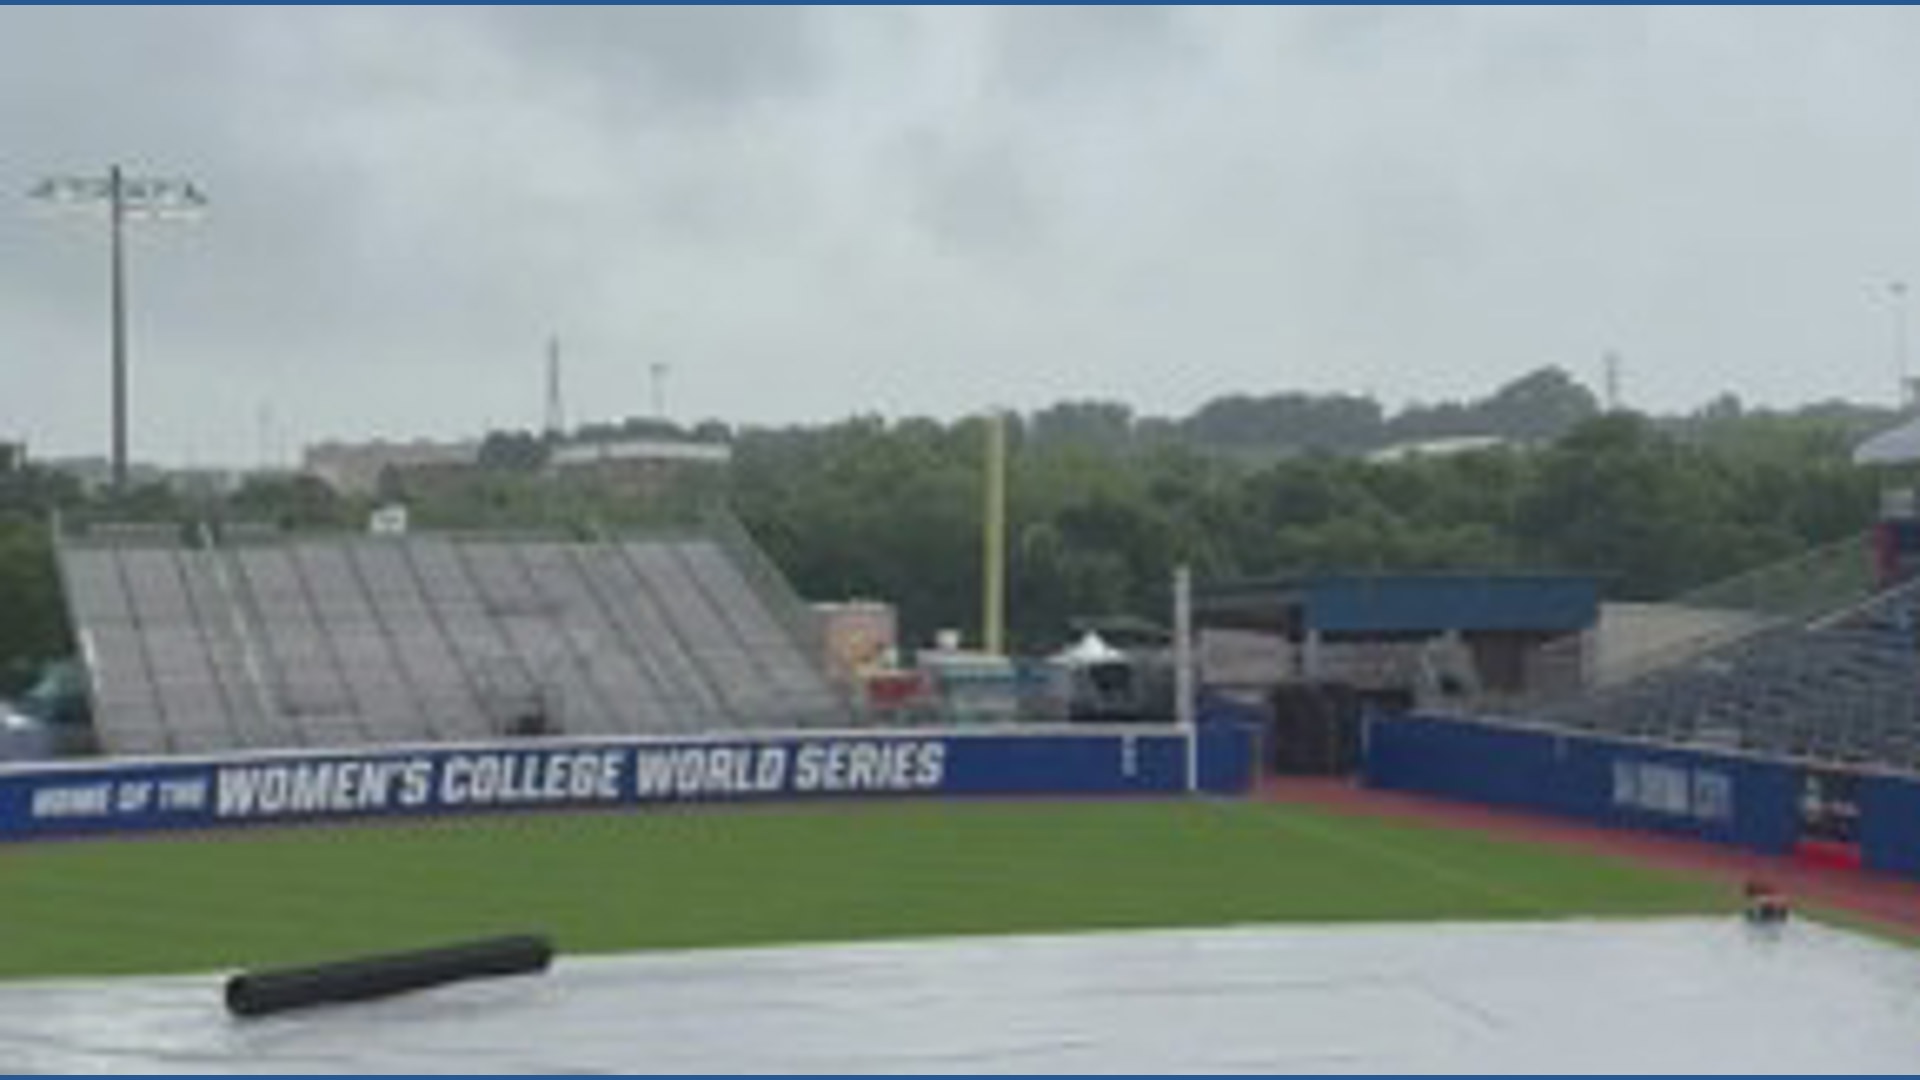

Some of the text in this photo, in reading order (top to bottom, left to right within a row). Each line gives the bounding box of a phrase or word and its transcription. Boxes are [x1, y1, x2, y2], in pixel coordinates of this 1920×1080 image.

[116, 781, 152, 812] OF
[214, 759, 433, 817] WOMEN'S
[441, 750, 620, 803] COLLEGE
[635, 746, 786, 797] WORLD
[794, 740, 946, 789] SERIES
